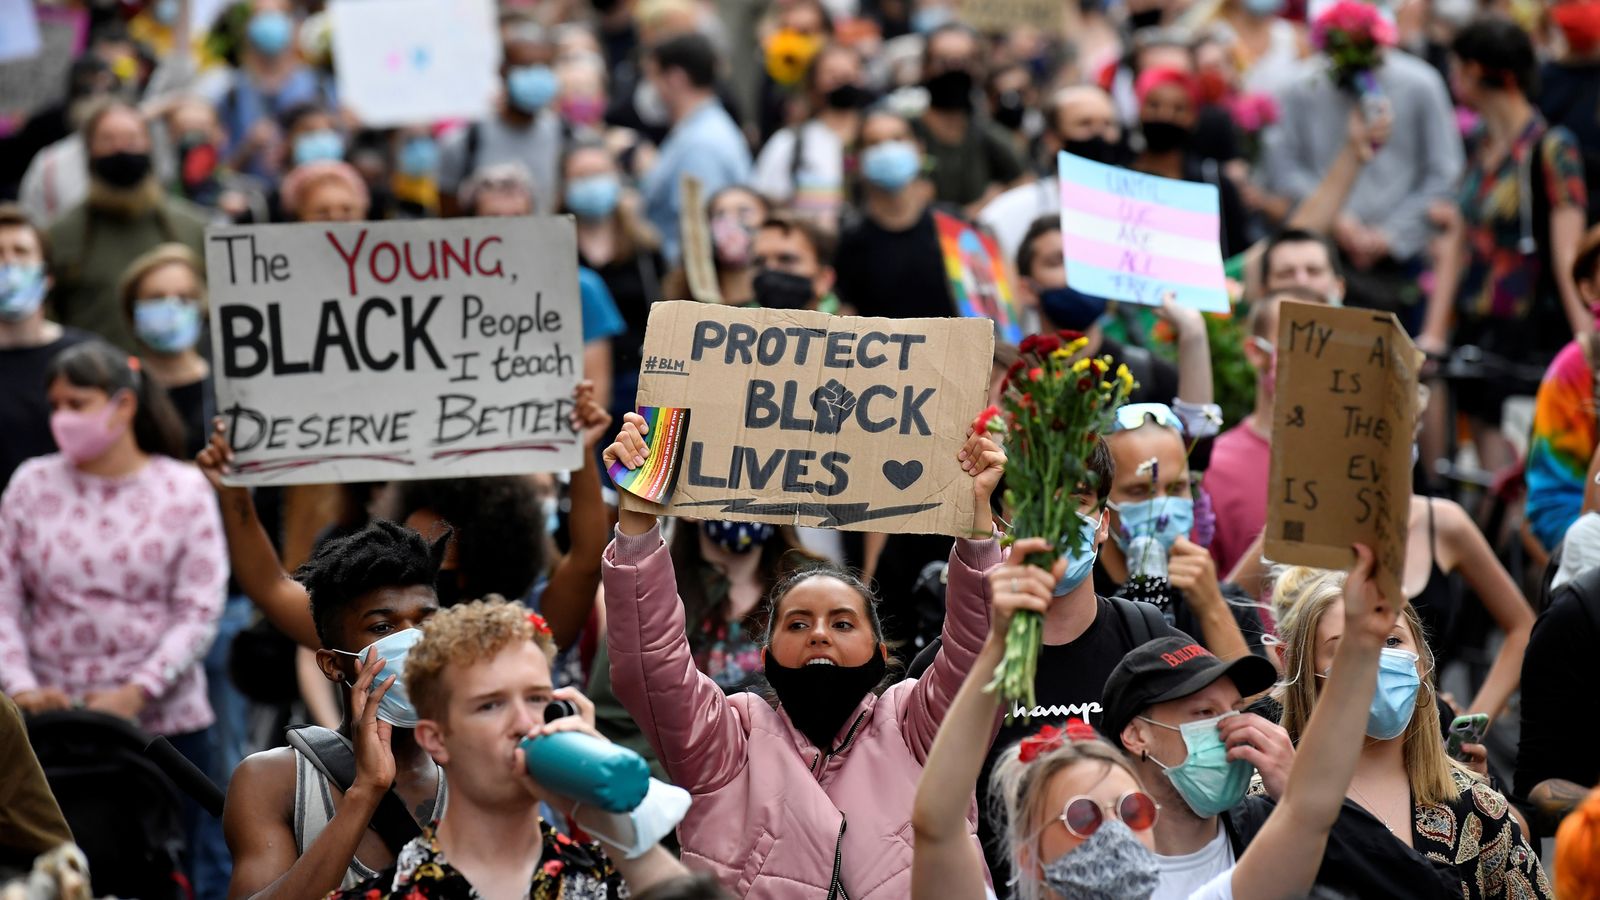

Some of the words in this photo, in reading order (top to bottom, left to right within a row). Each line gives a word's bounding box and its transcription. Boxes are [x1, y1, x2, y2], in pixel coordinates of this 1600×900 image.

[210, 233, 291, 284] The
[325, 228, 517, 296] YOUNG,
[219, 295, 447, 379] BLACK
[461, 291, 562, 350] People
[691, 320, 926, 371] PROTECT
[1290, 319, 1333, 360] MY
[449, 352, 480, 382] I
[491, 343, 574, 382] teach
[645, 356, 685, 372] #BLM
[1328, 369, 1362, 394] IS
[224, 401, 416, 451] DESERVE
[431, 394, 578, 445] BETTER
[745, 378, 936, 436] BLCK
[688, 441, 851, 496] LIVES
[1284, 477, 1318, 511] IS
